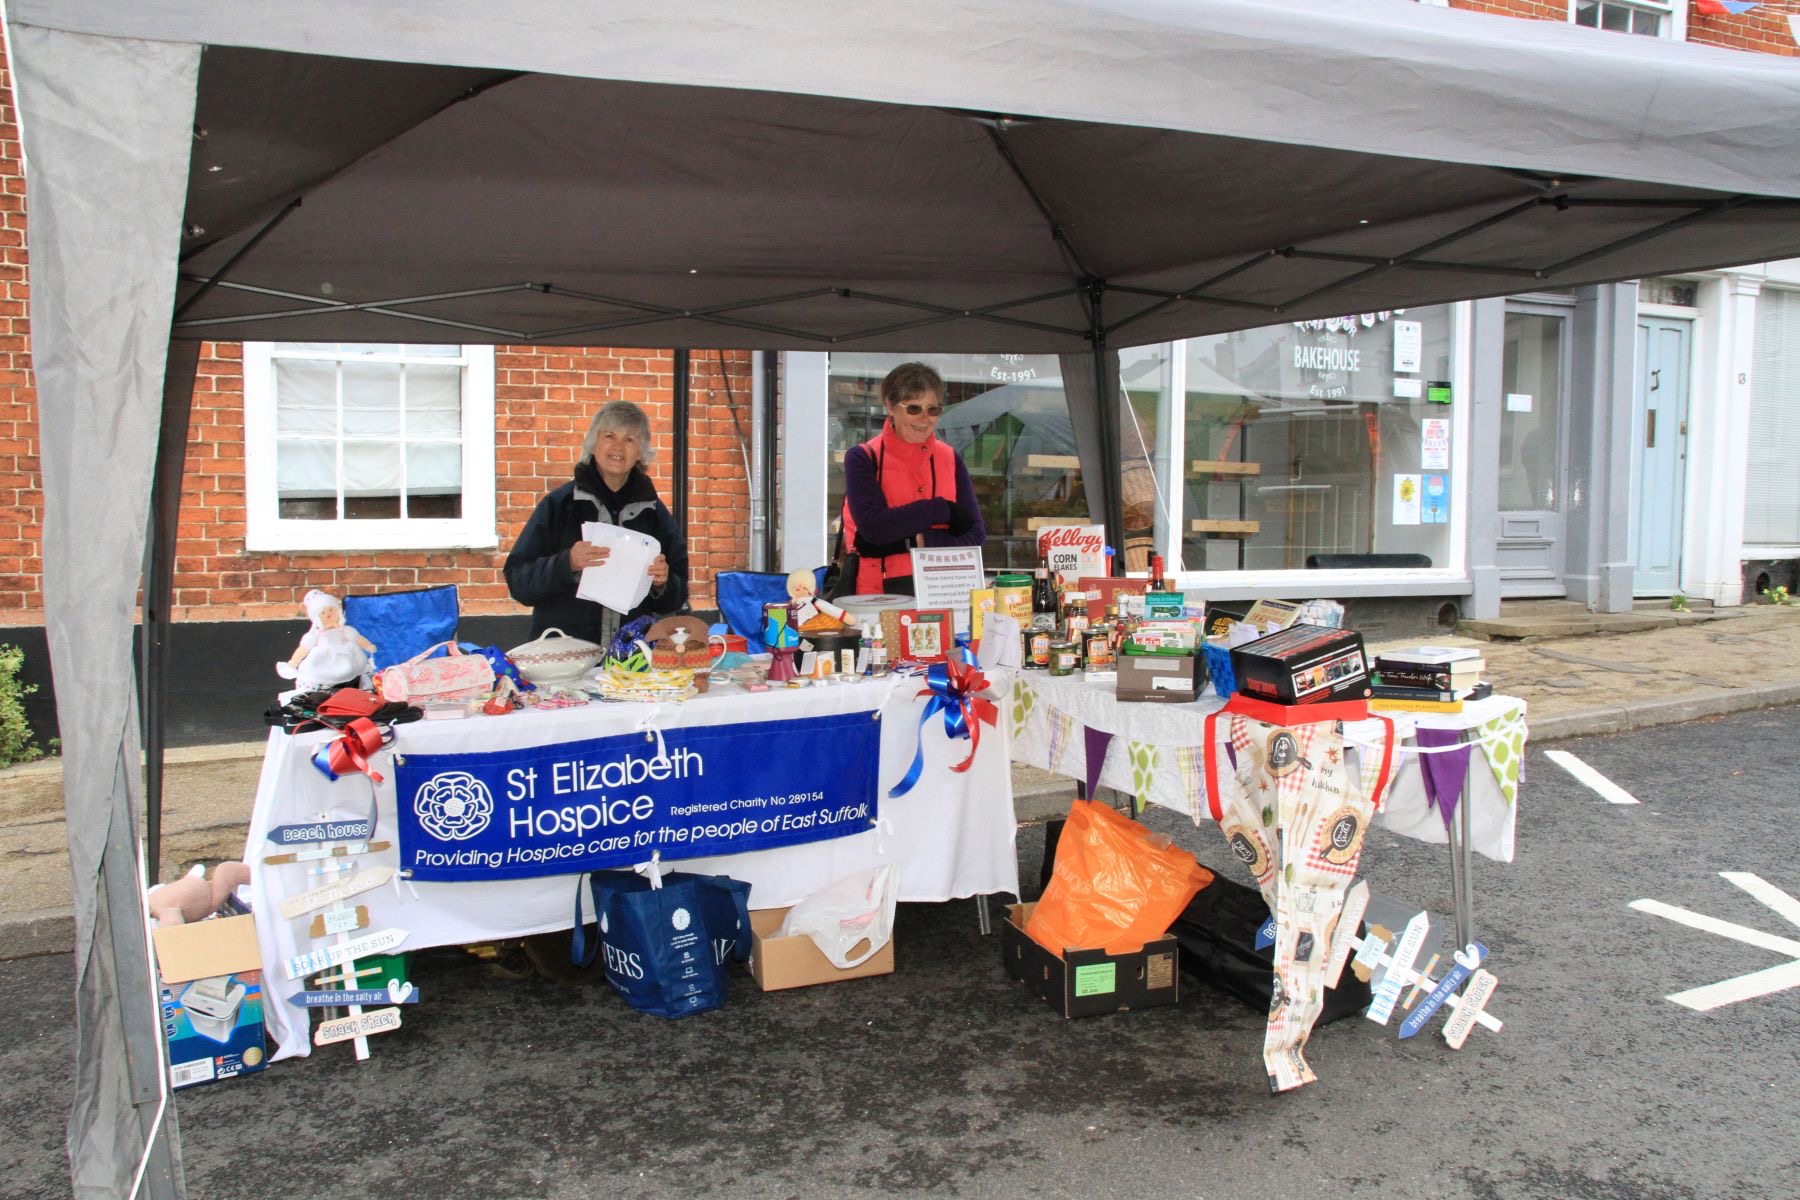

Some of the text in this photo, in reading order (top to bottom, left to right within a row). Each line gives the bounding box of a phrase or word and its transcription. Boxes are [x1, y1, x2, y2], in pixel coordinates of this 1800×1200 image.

[1294, 345, 1361, 372] BAKEHOUSE
[1310, 384, 1347, 399] Est 1991
[1053, 554, 1078, 564] CORN
[1053, 563, 1078, 571] FLAKES
[506, 747, 704, 801] St Elizabeth
[510, 794, 654, 839] Hospice
[670, 791, 824, 816] Registered Charity No 289154
[283, 822, 369, 842] Beach house
[415, 802, 868, 868] Providing Hospice care for the people of East Suffolk
[328, 950, 343, 962] UP
[344, 941, 371, 957] THE
[370, 933, 395, 947] SUN
[1410, 924, 1423, 946] SUN
[306, 991, 383, 1004] breathe in the salty air
[1408, 1002, 1433, 1029] breathe
[1433, 988, 1445, 1002] the
[1443, 978, 1457, 995] salty
[1454, 970, 1462, 981] air
[322, 1012, 397, 1040] snack shack
